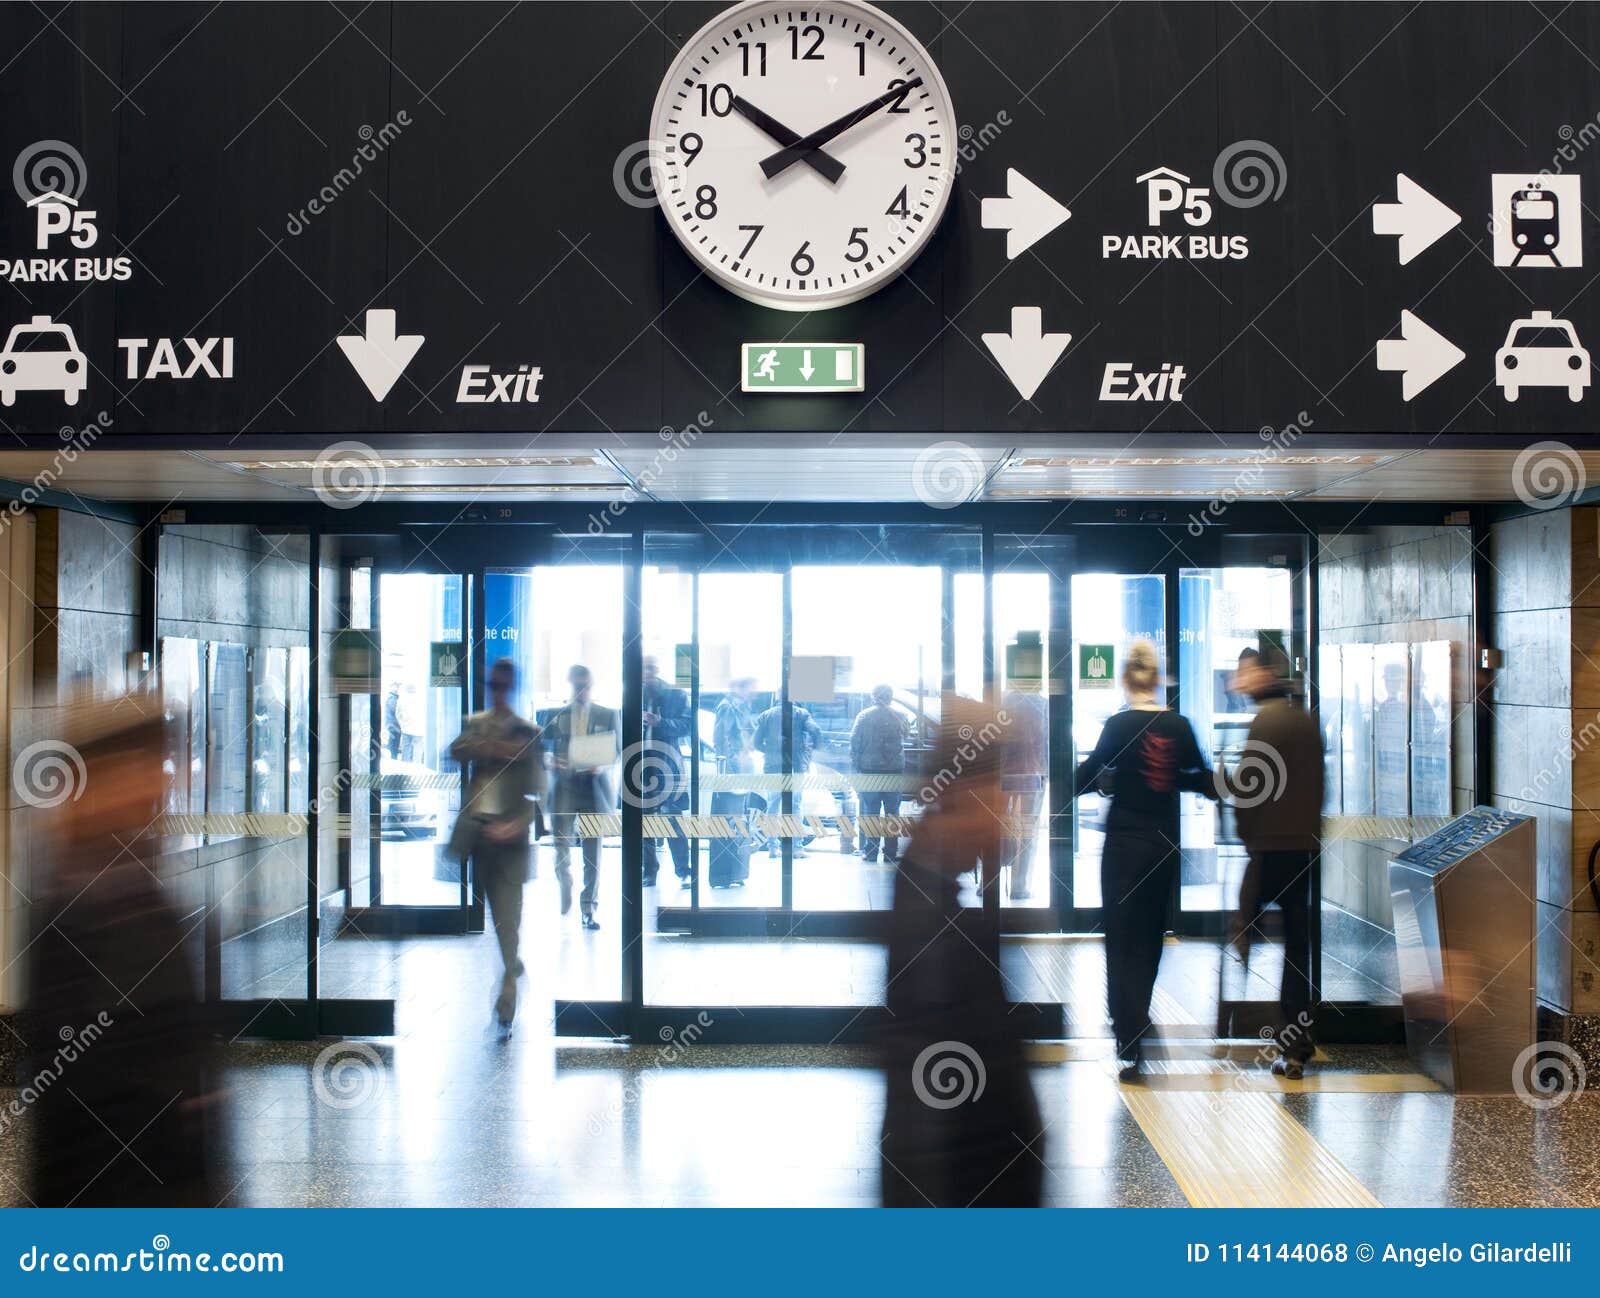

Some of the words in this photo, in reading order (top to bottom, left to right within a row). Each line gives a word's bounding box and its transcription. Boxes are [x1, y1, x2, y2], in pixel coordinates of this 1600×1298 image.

[737, 42, 767, 76] 11
[787, 25, 825, 60] 12
[853, 42, 866, 76] 1
[697, 83, 734, 118] 10
[886, 79, 911, 114] 2
[679, 132, 704, 168] 9
[904, 133, 927, 169] 3
[694, 184, 718, 220] 8
[885, 184, 911, 220] 4
[1148, 179, 1212, 227] P5
[37, 202, 98, 250] P5
[738, 225, 765, 260] 7
[790, 241, 815, 277] 6
[844, 227, 869, 263] 5
[1102, 236, 1183, 259] PARK
[1189, 236, 1249, 260] BUS
[0, 258, 69, 282] PARK
[74, 257, 132, 281] BUS
[118, 338, 234, 379] TAXI
[456, 365, 544, 403] Exit
[1099, 363, 1187, 402] Exit
[501, 626, 519, 643] city
